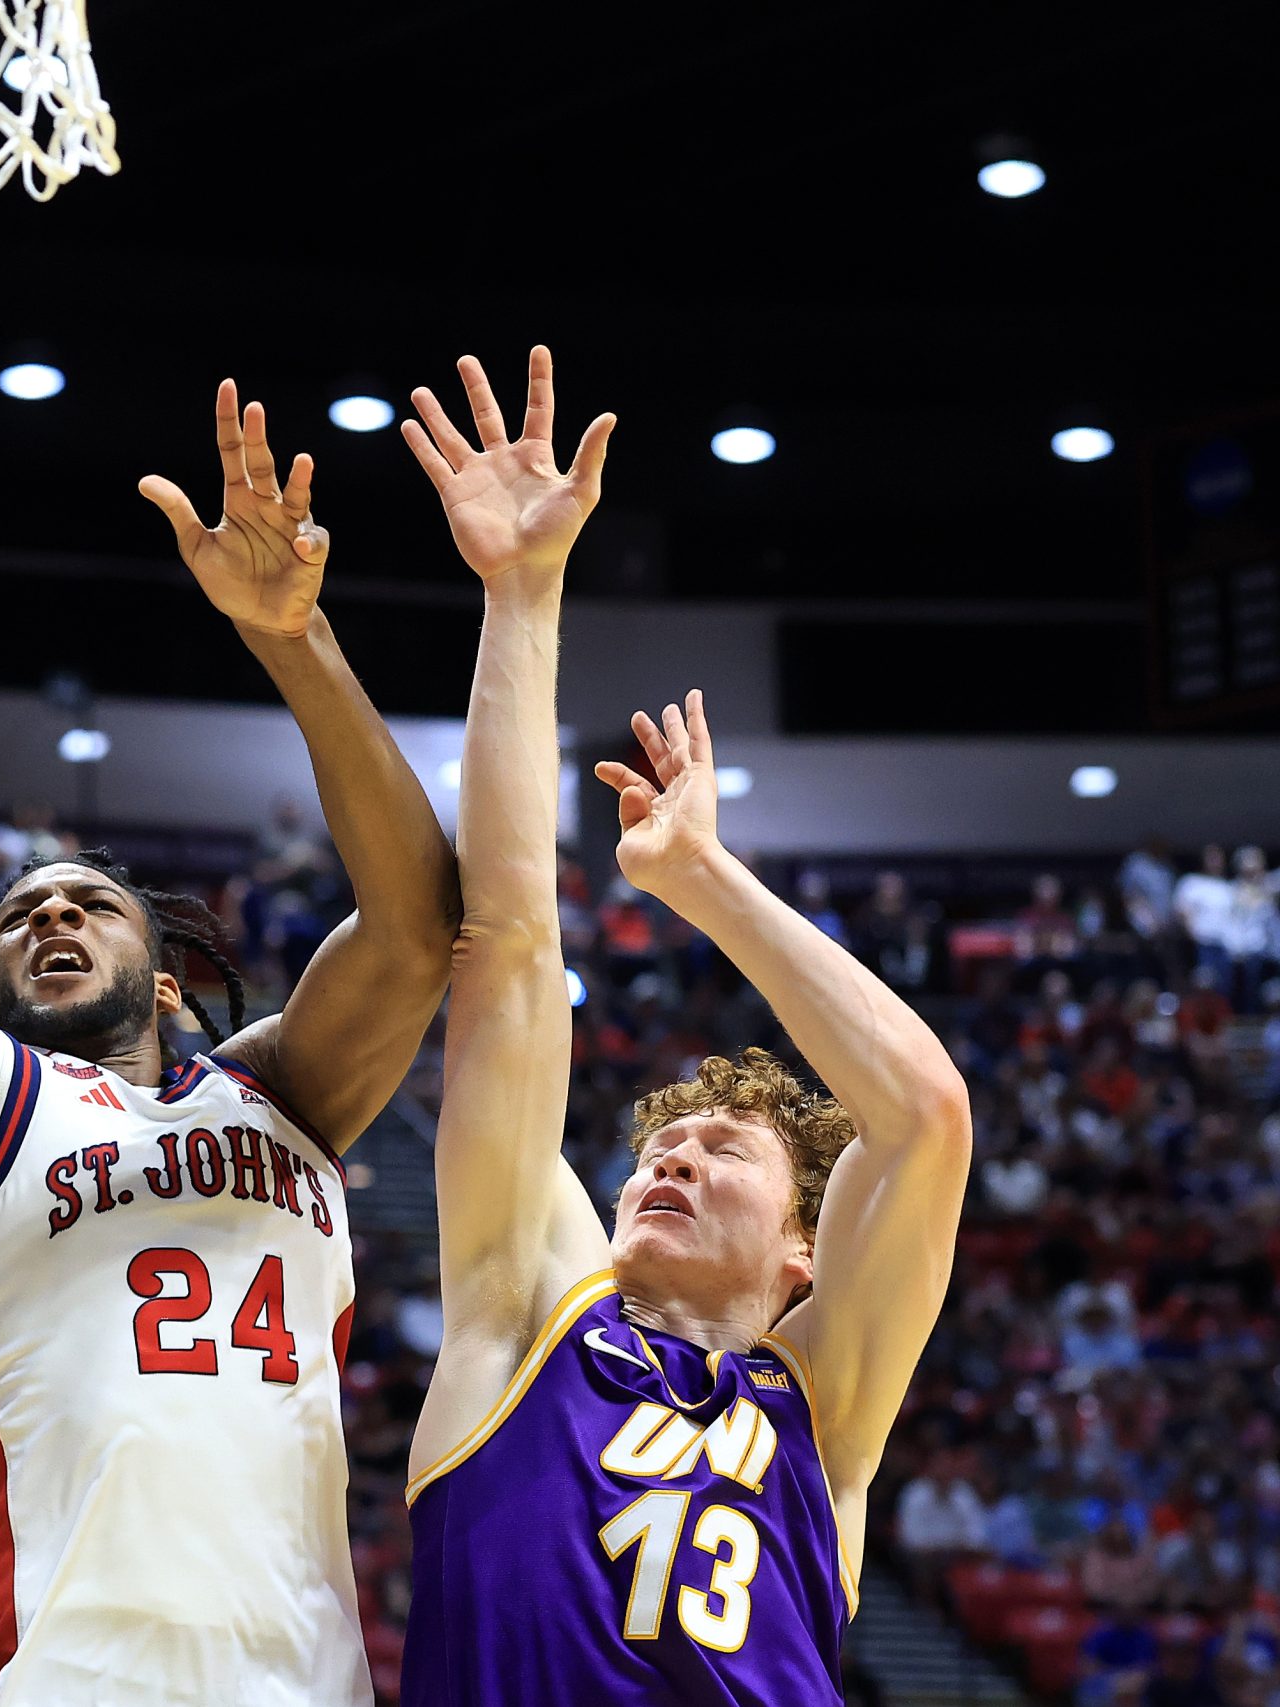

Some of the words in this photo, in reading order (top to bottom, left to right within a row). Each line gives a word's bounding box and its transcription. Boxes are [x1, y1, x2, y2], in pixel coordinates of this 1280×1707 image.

[45, 1141, 134, 1239] ST.
[143, 1126, 333, 1238] JOHN'S
[126, 1247, 300, 1385] 24
[748, 1369, 790, 1389] VALLEY
[599, 1397, 778, 1491] UNI
[598, 1489, 760, 1654] 13
